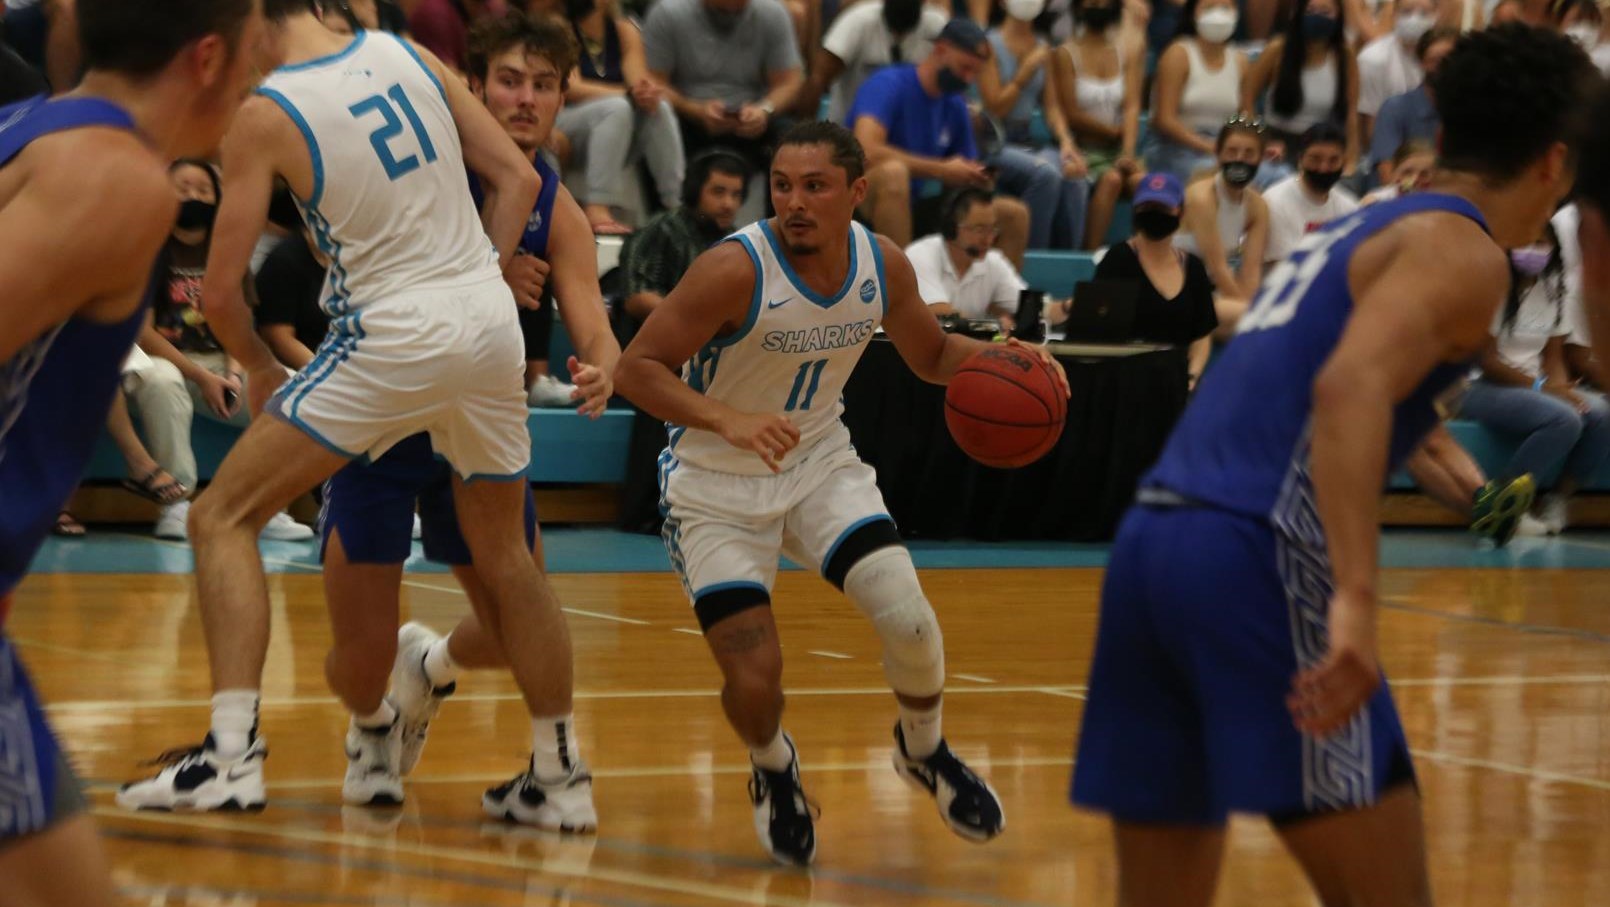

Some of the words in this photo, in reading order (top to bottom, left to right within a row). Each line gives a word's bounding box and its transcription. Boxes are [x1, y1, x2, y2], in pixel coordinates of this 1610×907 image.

[348, 82, 438, 183] 21
[760, 319, 874, 354] SHARKS
[784, 358, 829, 412] 11
